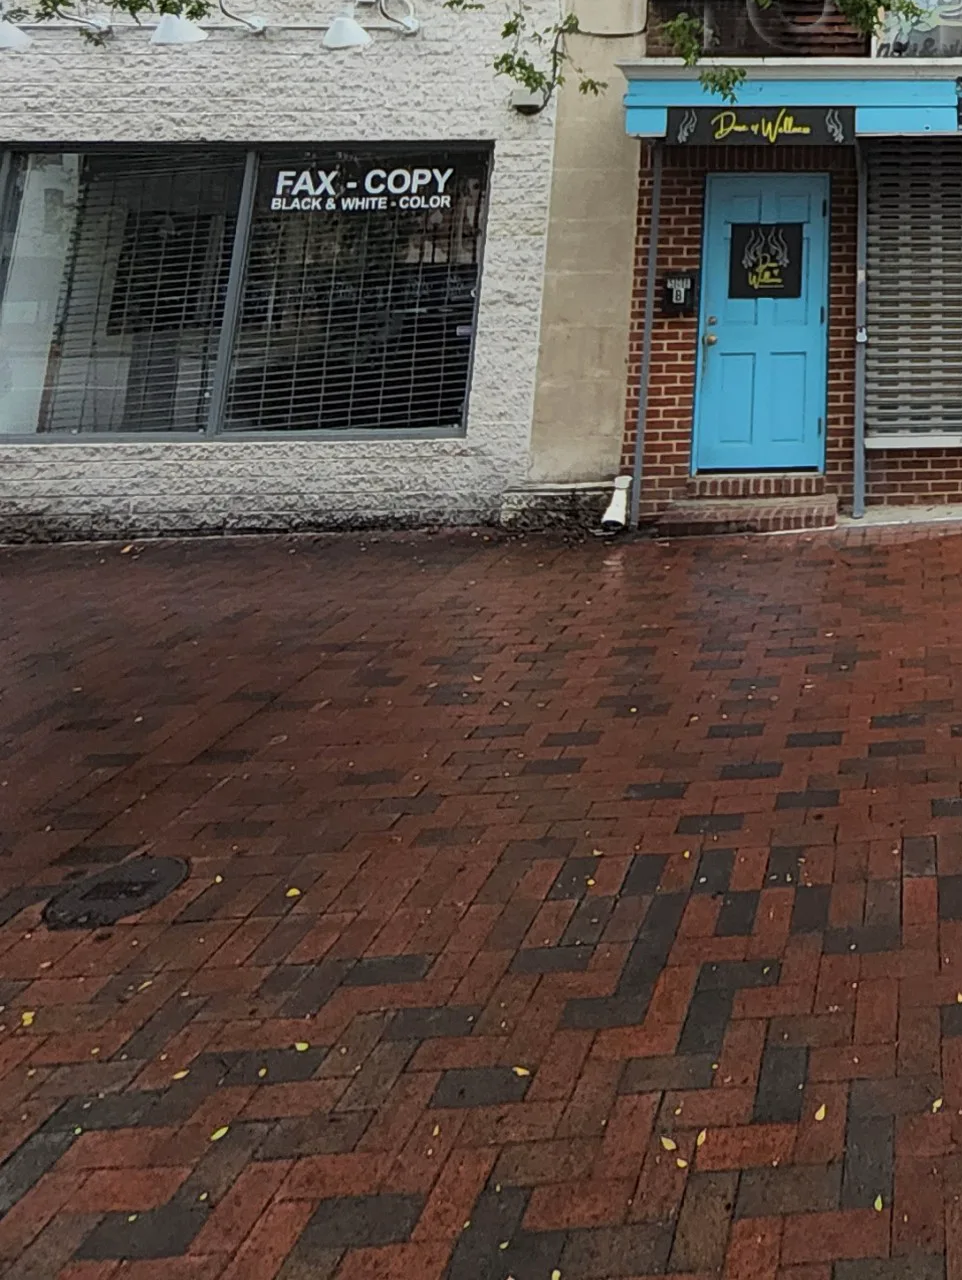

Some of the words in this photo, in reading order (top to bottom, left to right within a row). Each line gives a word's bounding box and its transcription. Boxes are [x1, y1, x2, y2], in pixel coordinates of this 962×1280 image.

[275, 170, 339, 196] FAX
[364, 168, 454, 195] COPY
[270, 197, 322, 211] BLACK
[325, 197, 337, 210] &
[341, 196, 388, 210] WHITE
[399, 195, 451, 209] COLOR
